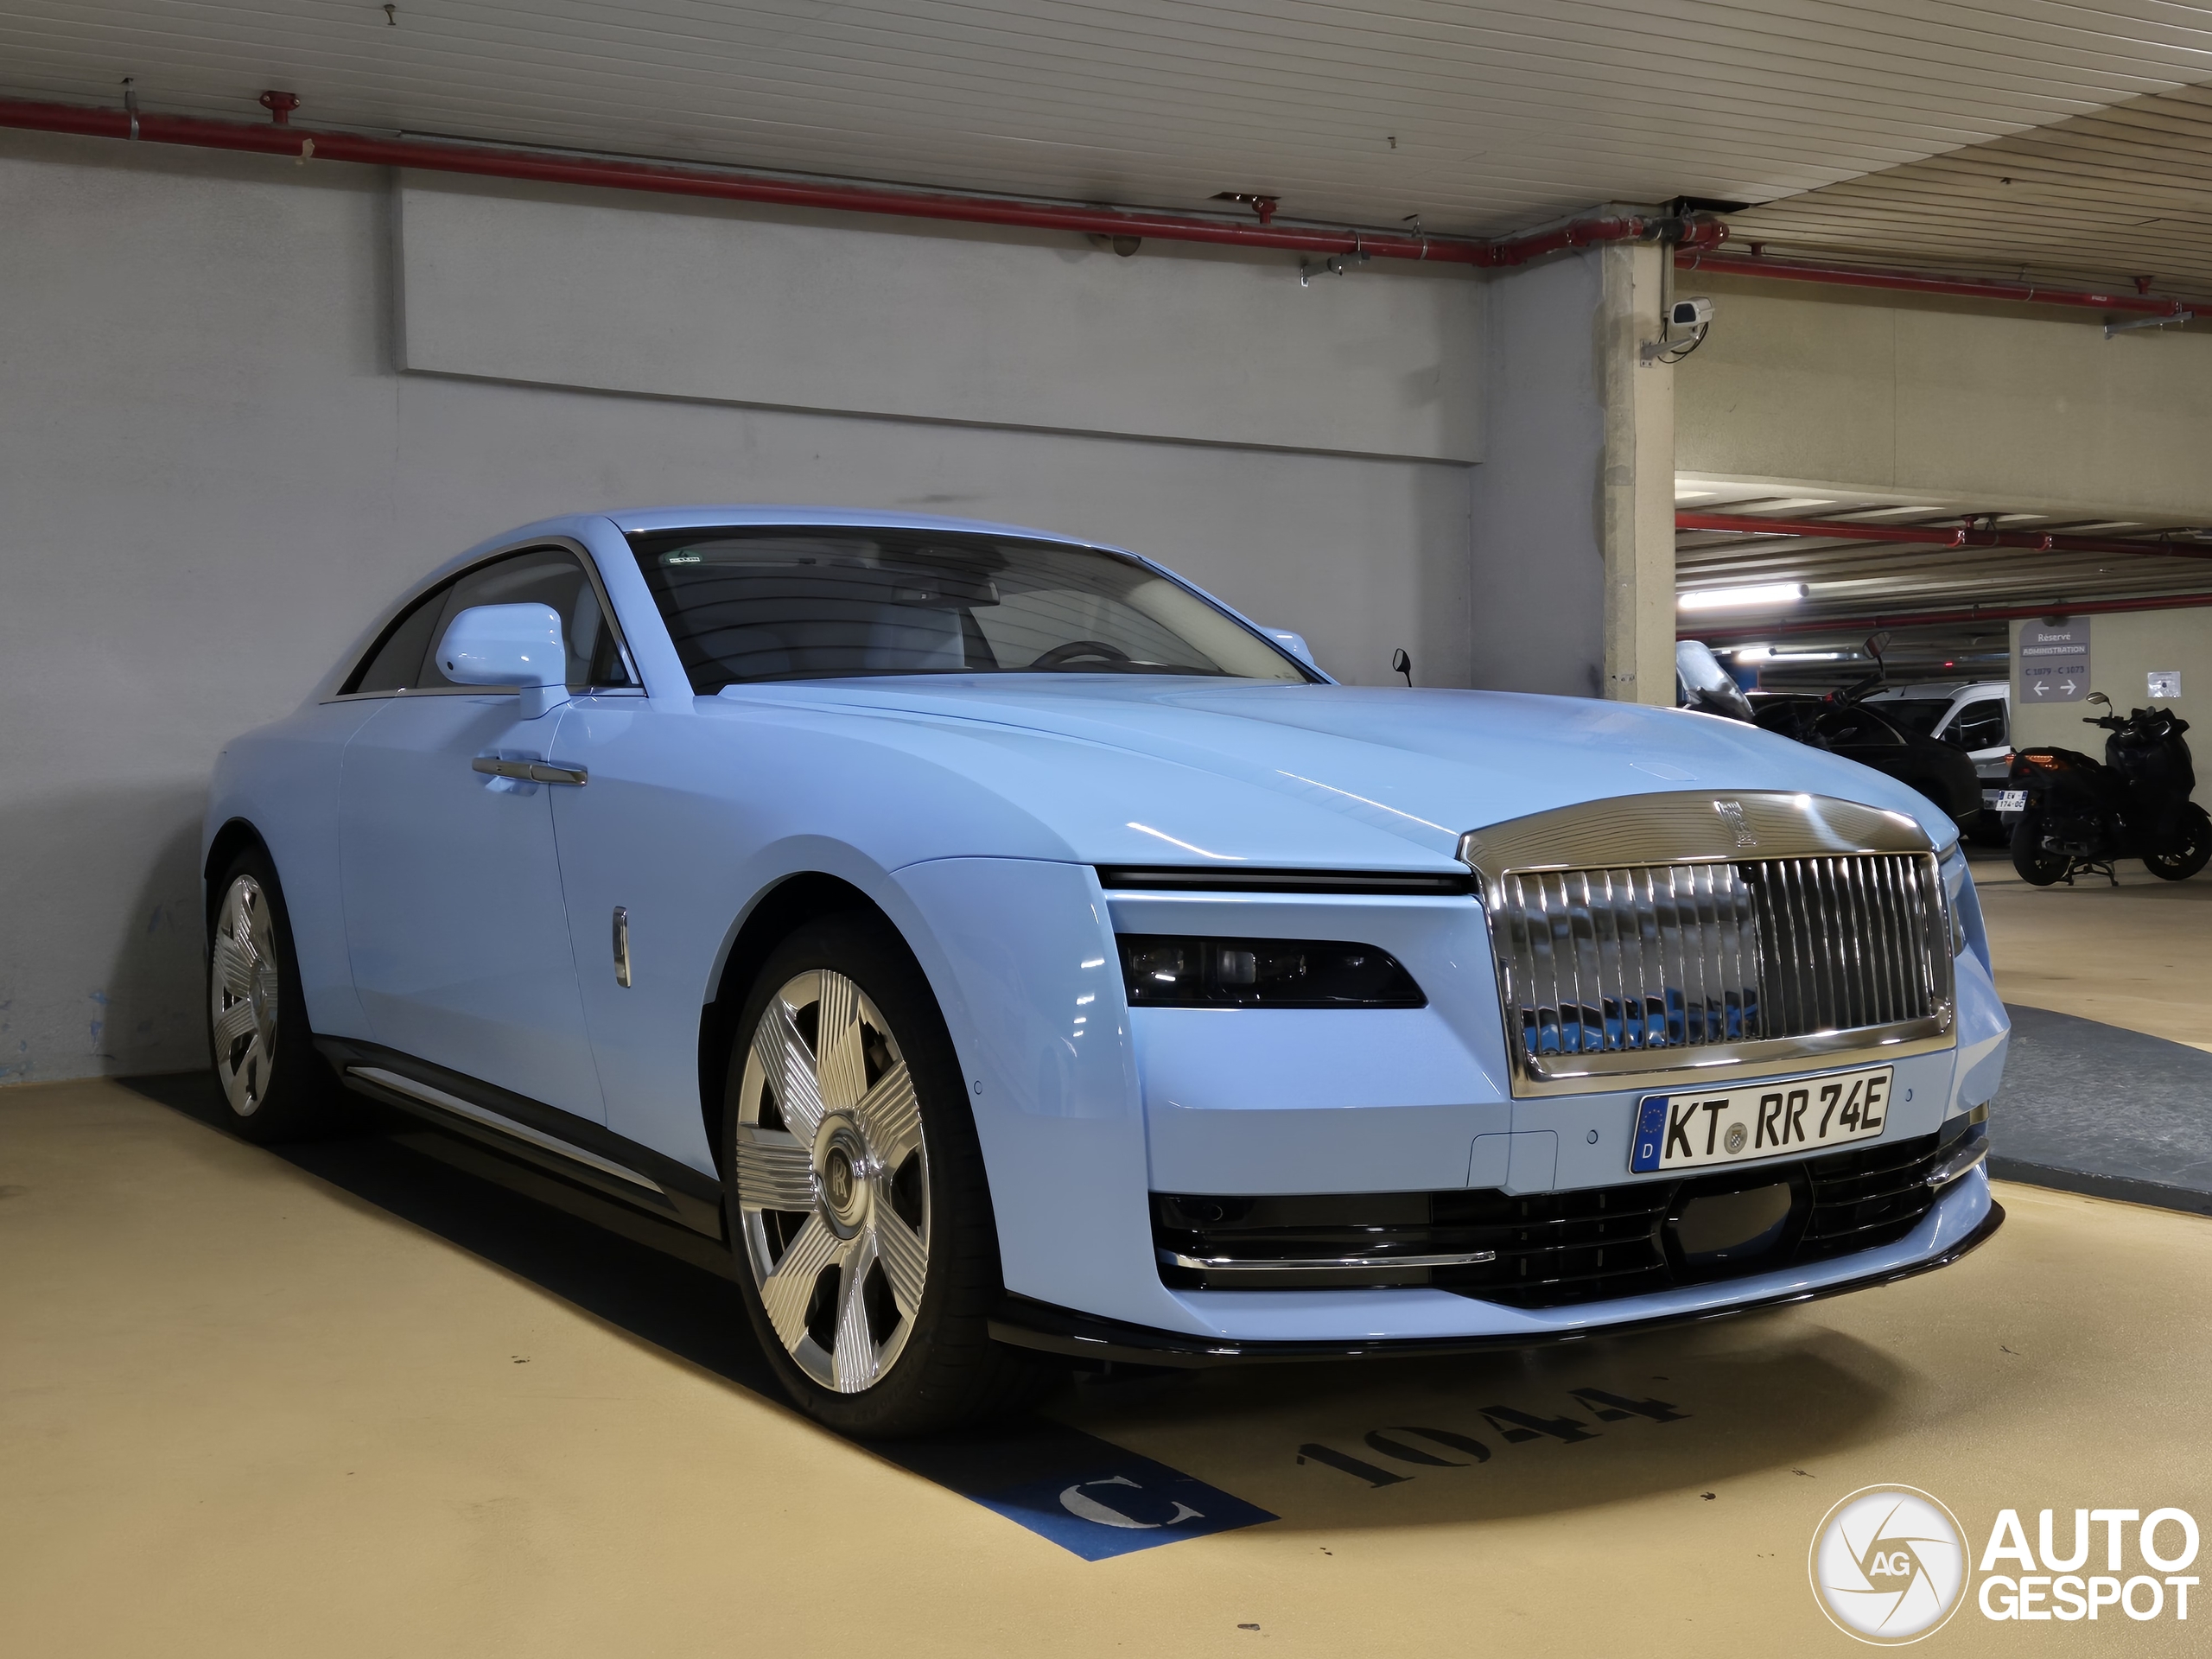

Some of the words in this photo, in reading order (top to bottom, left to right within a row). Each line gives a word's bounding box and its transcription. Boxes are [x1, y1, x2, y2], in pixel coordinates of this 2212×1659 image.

[2023, 646, 2085, 656] ADMINISTRATION
[2037, 632, 2071, 642] Réservé
[2034, 667, 2051, 676] 1079
[2066, 665, 2085, 674] 1073
[1643, 1143, 1653, 1159] D
[1665, 1098, 1729, 1159] KT
[1755, 1089, 1809, 1148] RR
[1819, 1076, 1888, 1138] 74E
[1296, 1387, 1694, 1489] 1044
[1059, 1476, 1205, 1529] C
